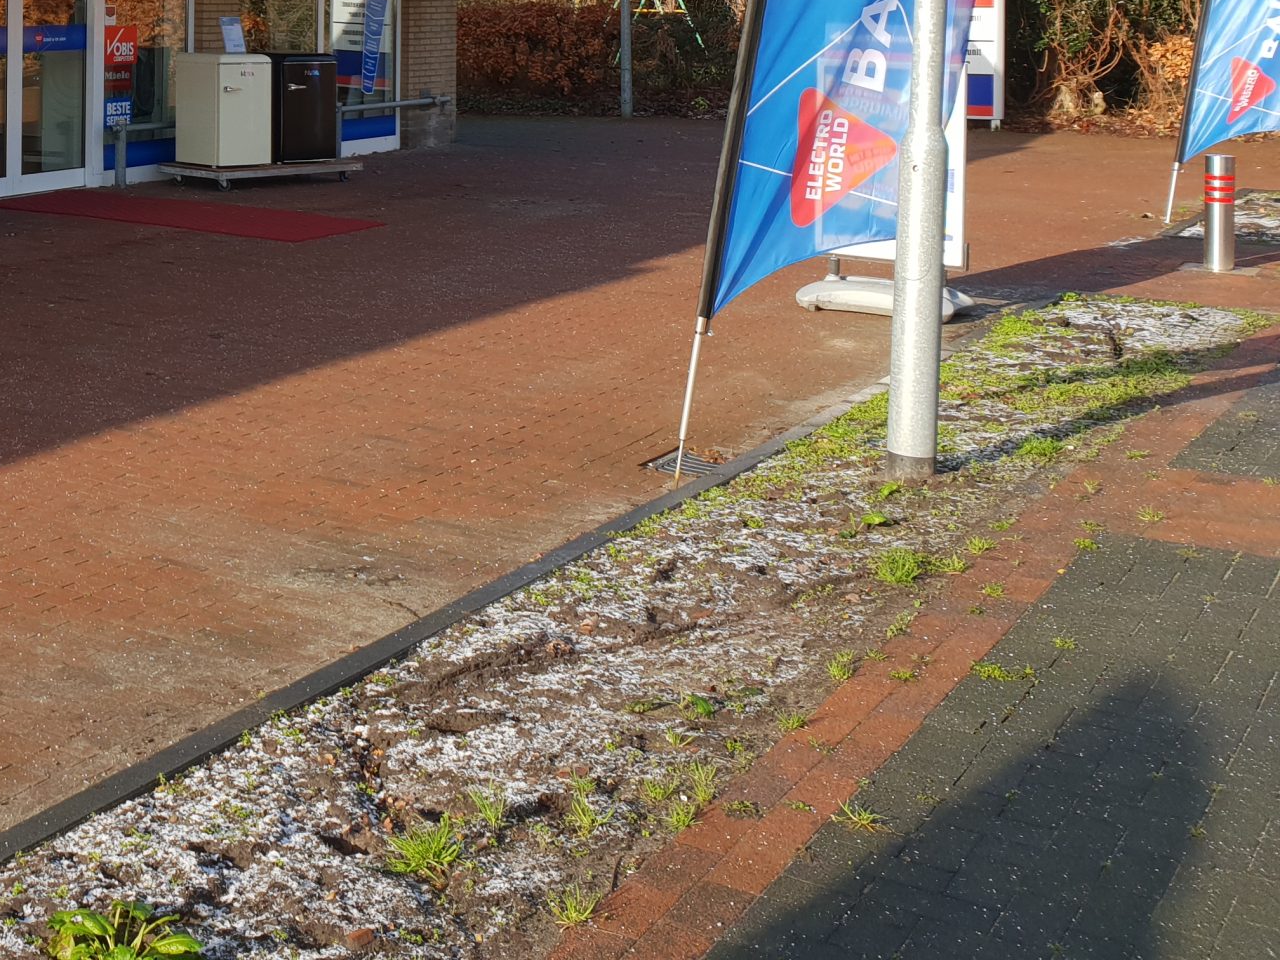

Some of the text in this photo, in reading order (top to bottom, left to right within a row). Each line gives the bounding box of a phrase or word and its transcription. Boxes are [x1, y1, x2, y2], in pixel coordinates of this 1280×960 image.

[107, 28, 134, 55] VOBIS
[106, 101, 131, 115] BESTE
[805, 109, 833, 200] ELECTRO
[824, 117, 849, 193] WORLD
